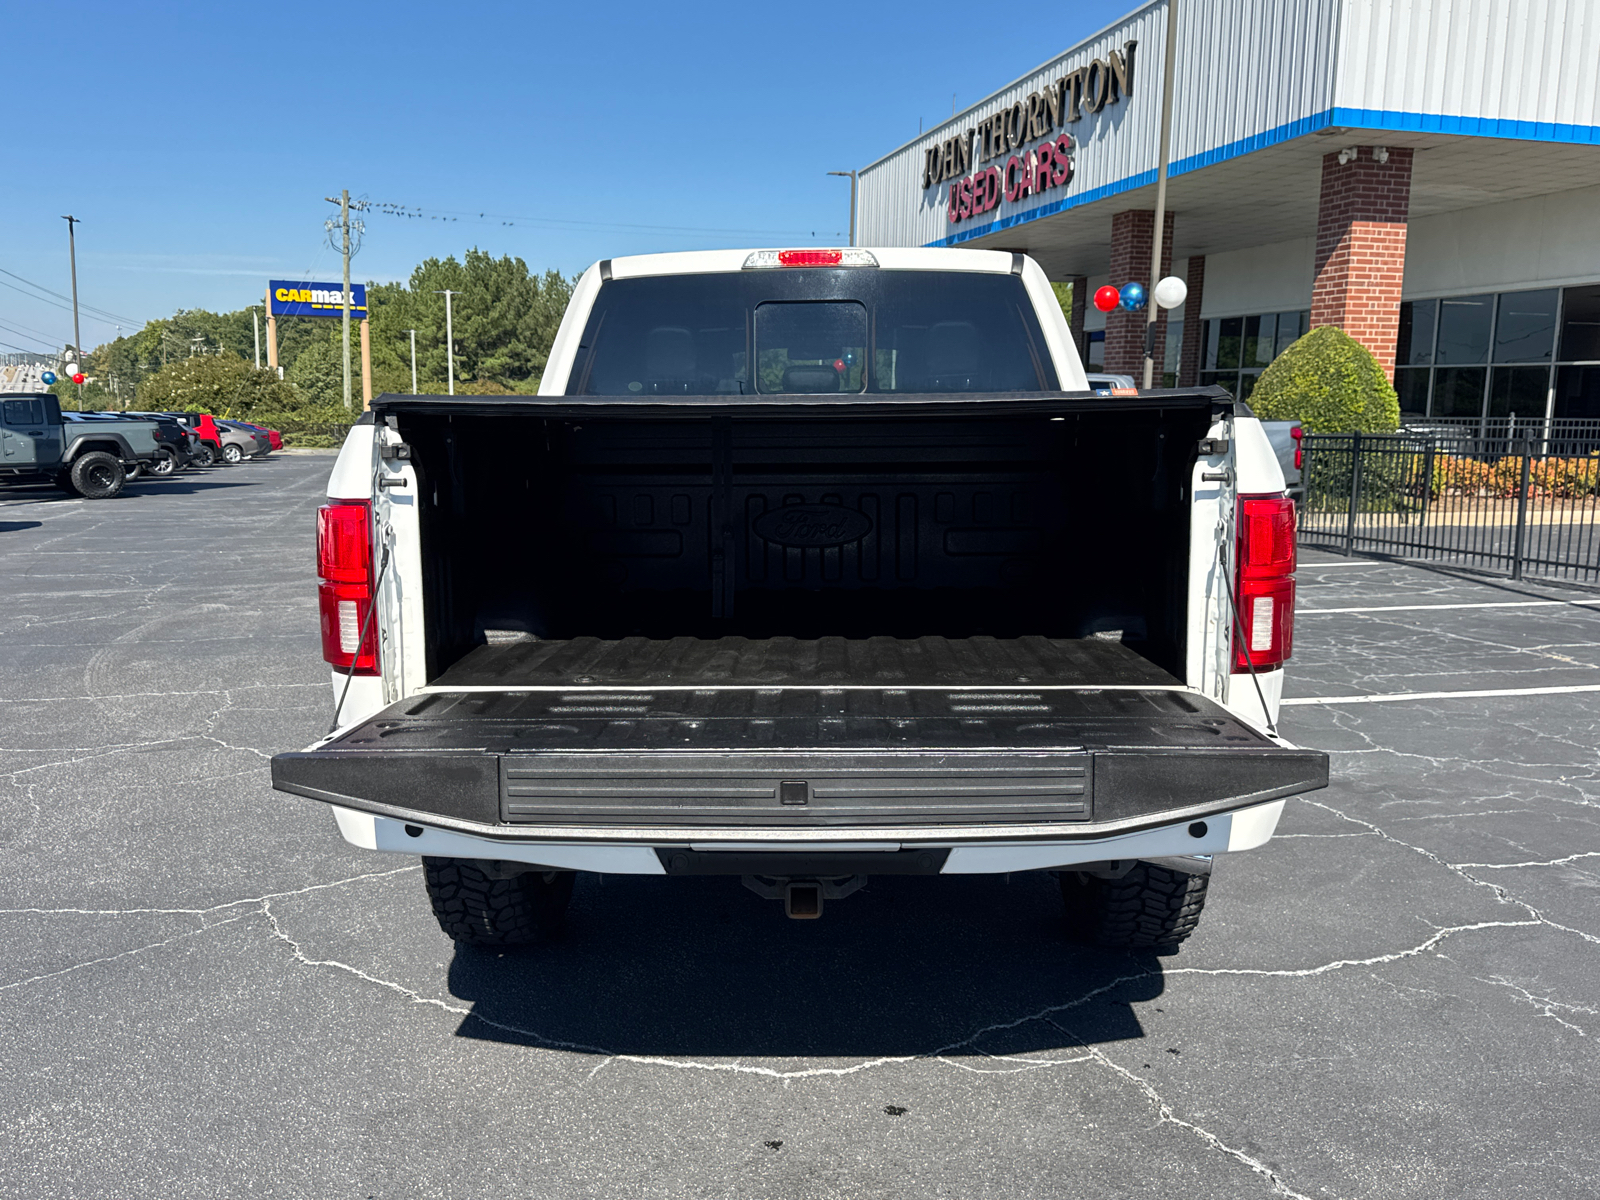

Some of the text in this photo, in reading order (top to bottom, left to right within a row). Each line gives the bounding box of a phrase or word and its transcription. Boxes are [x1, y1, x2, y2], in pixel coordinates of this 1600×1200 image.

[922, 40, 1138, 190] JOHN THORNTON
[948, 133, 1075, 223] USED CARS
[775, 510, 848, 539] Ford
